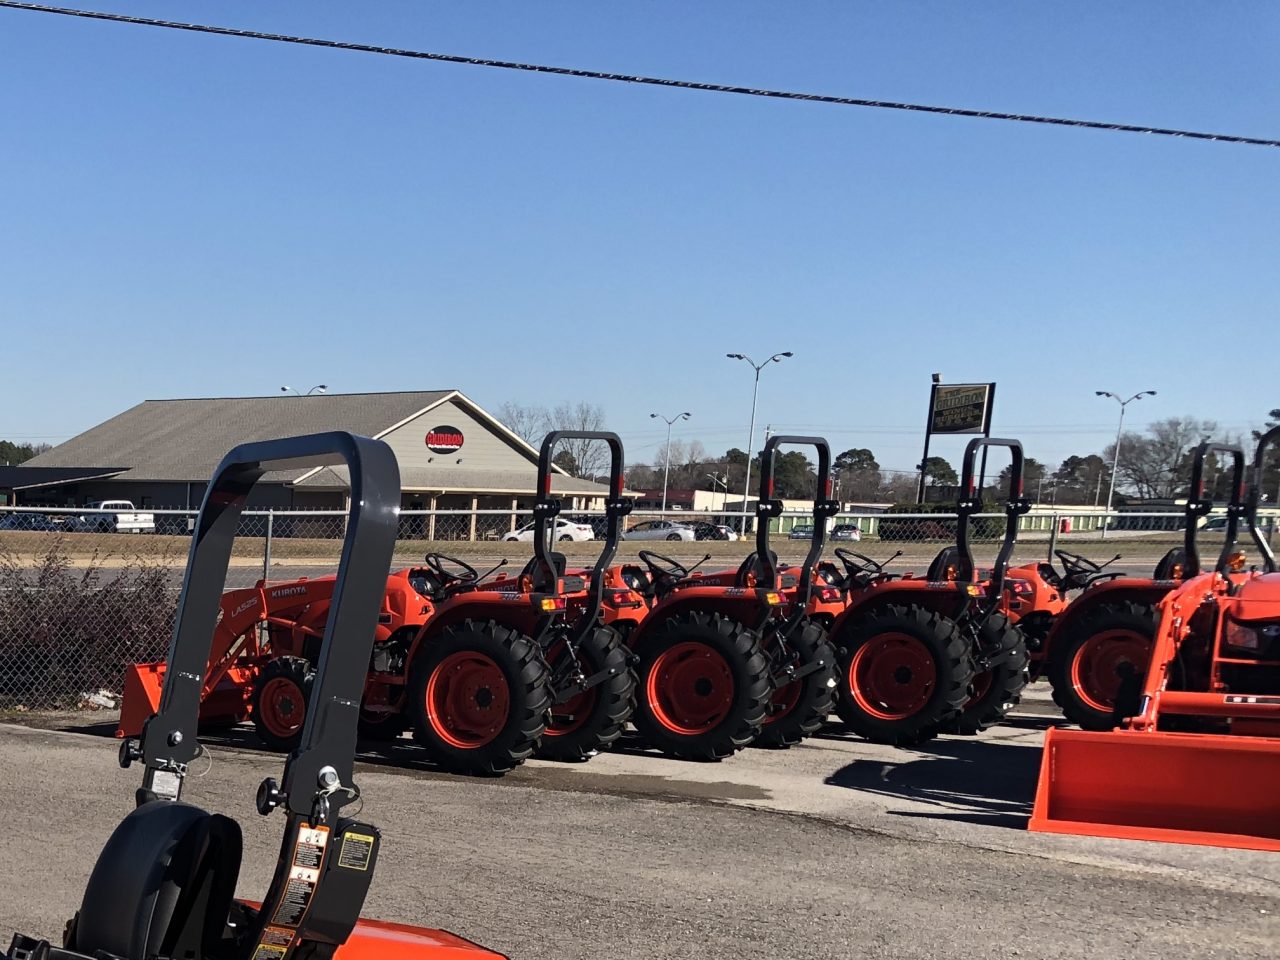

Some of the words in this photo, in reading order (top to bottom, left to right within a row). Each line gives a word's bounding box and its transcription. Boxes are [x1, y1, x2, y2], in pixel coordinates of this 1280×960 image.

[936, 391, 985, 411] GRIDIRON
[428, 433, 463, 445] GRIDIRON
[272, 585, 307, 599] KUBOTA
[231, 596, 258, 618] LA525
